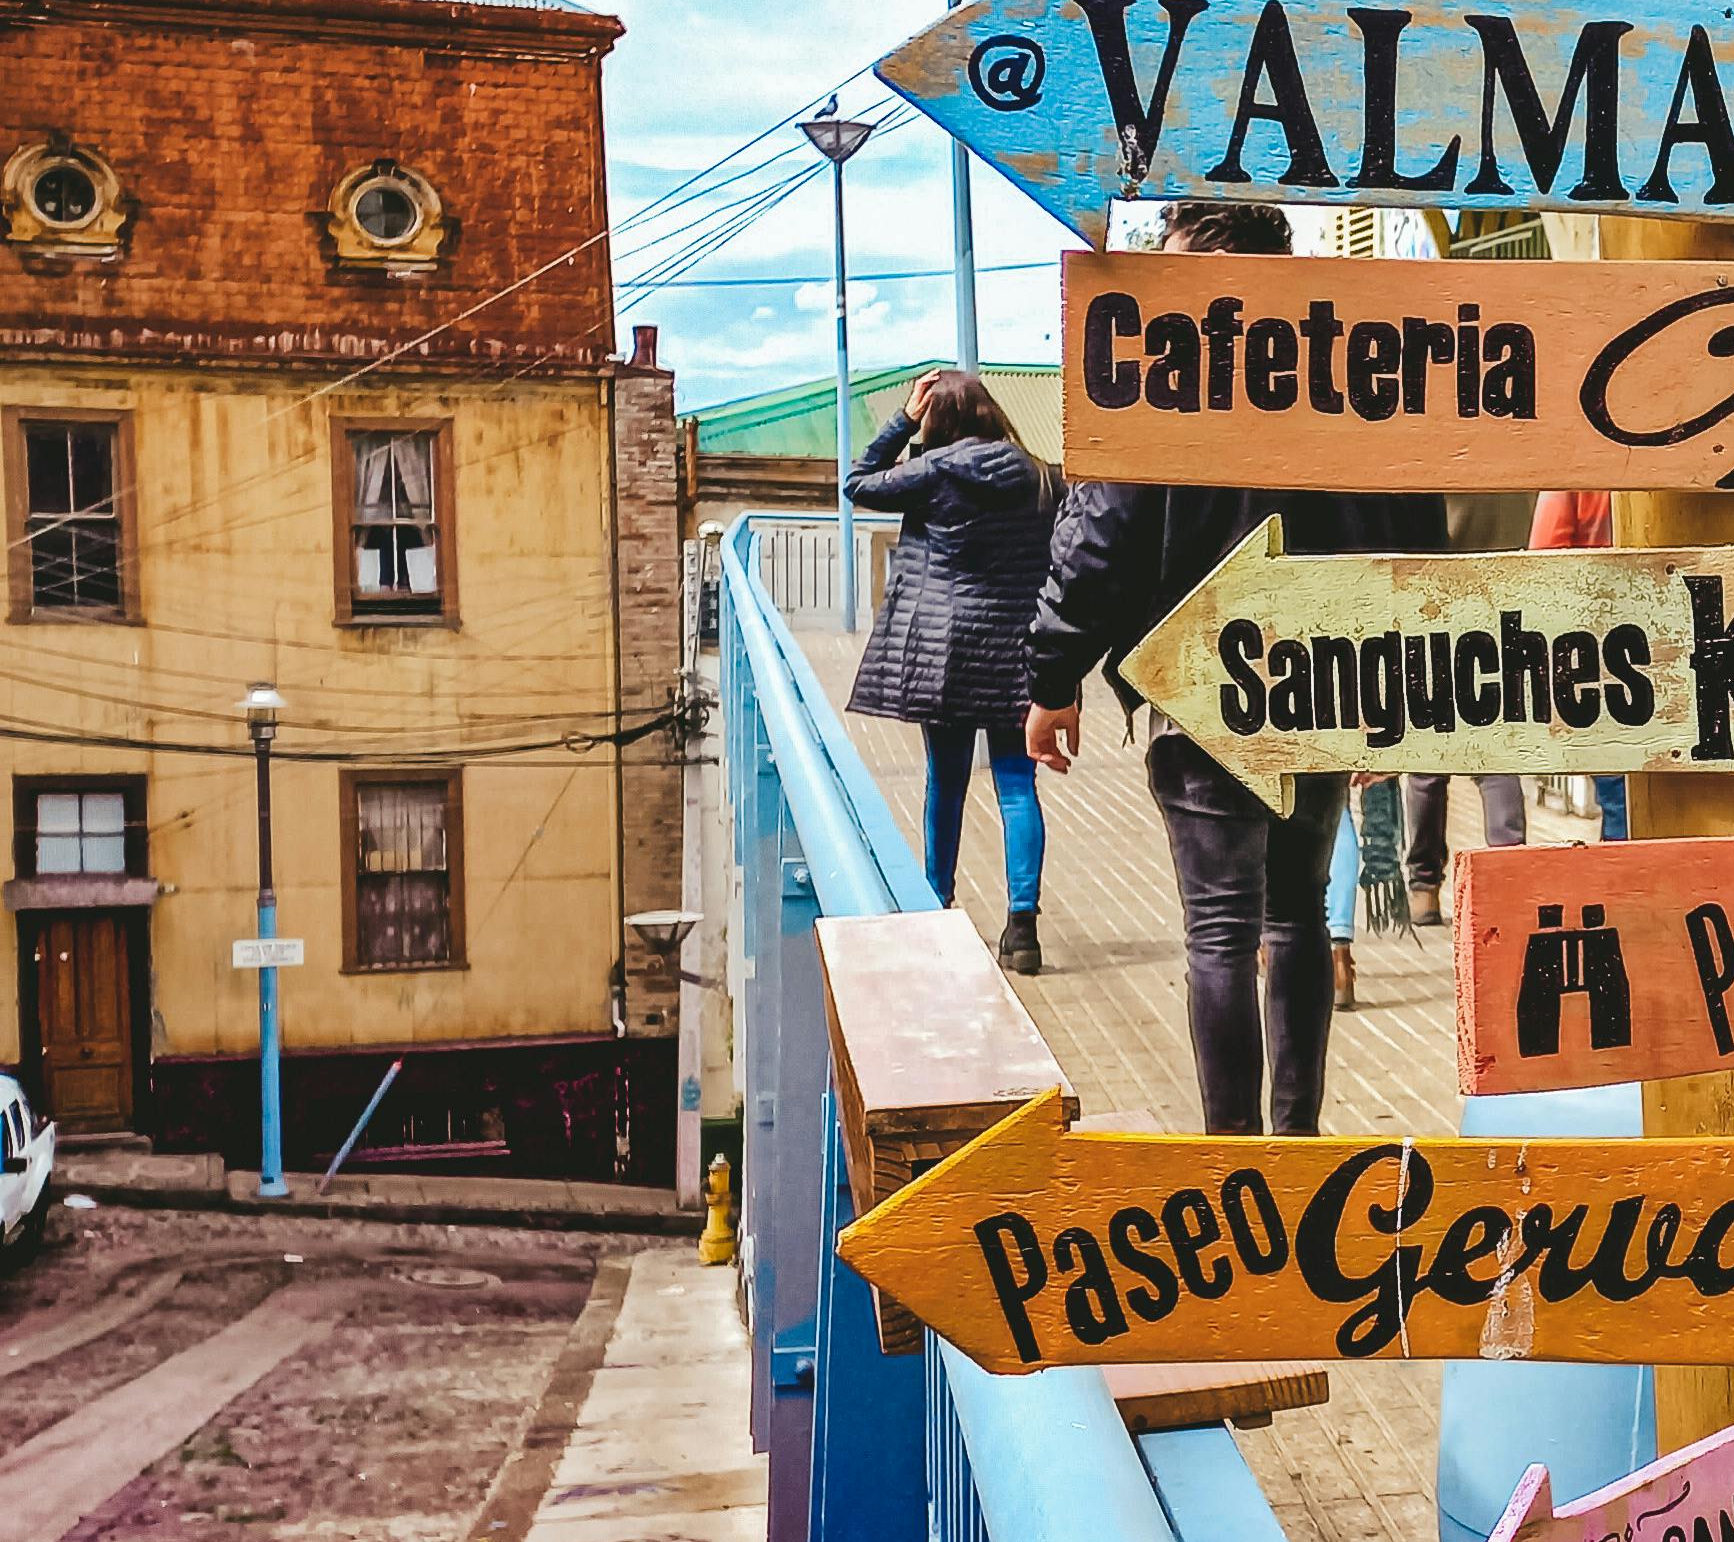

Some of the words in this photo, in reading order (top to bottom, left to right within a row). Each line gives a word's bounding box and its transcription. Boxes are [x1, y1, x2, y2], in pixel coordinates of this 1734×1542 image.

[1084, 292, 1536, 422] Cafeteria
[1218, 609, 1655, 749] Sanguches
[974, 1168, 1289, 1363] Paseo
